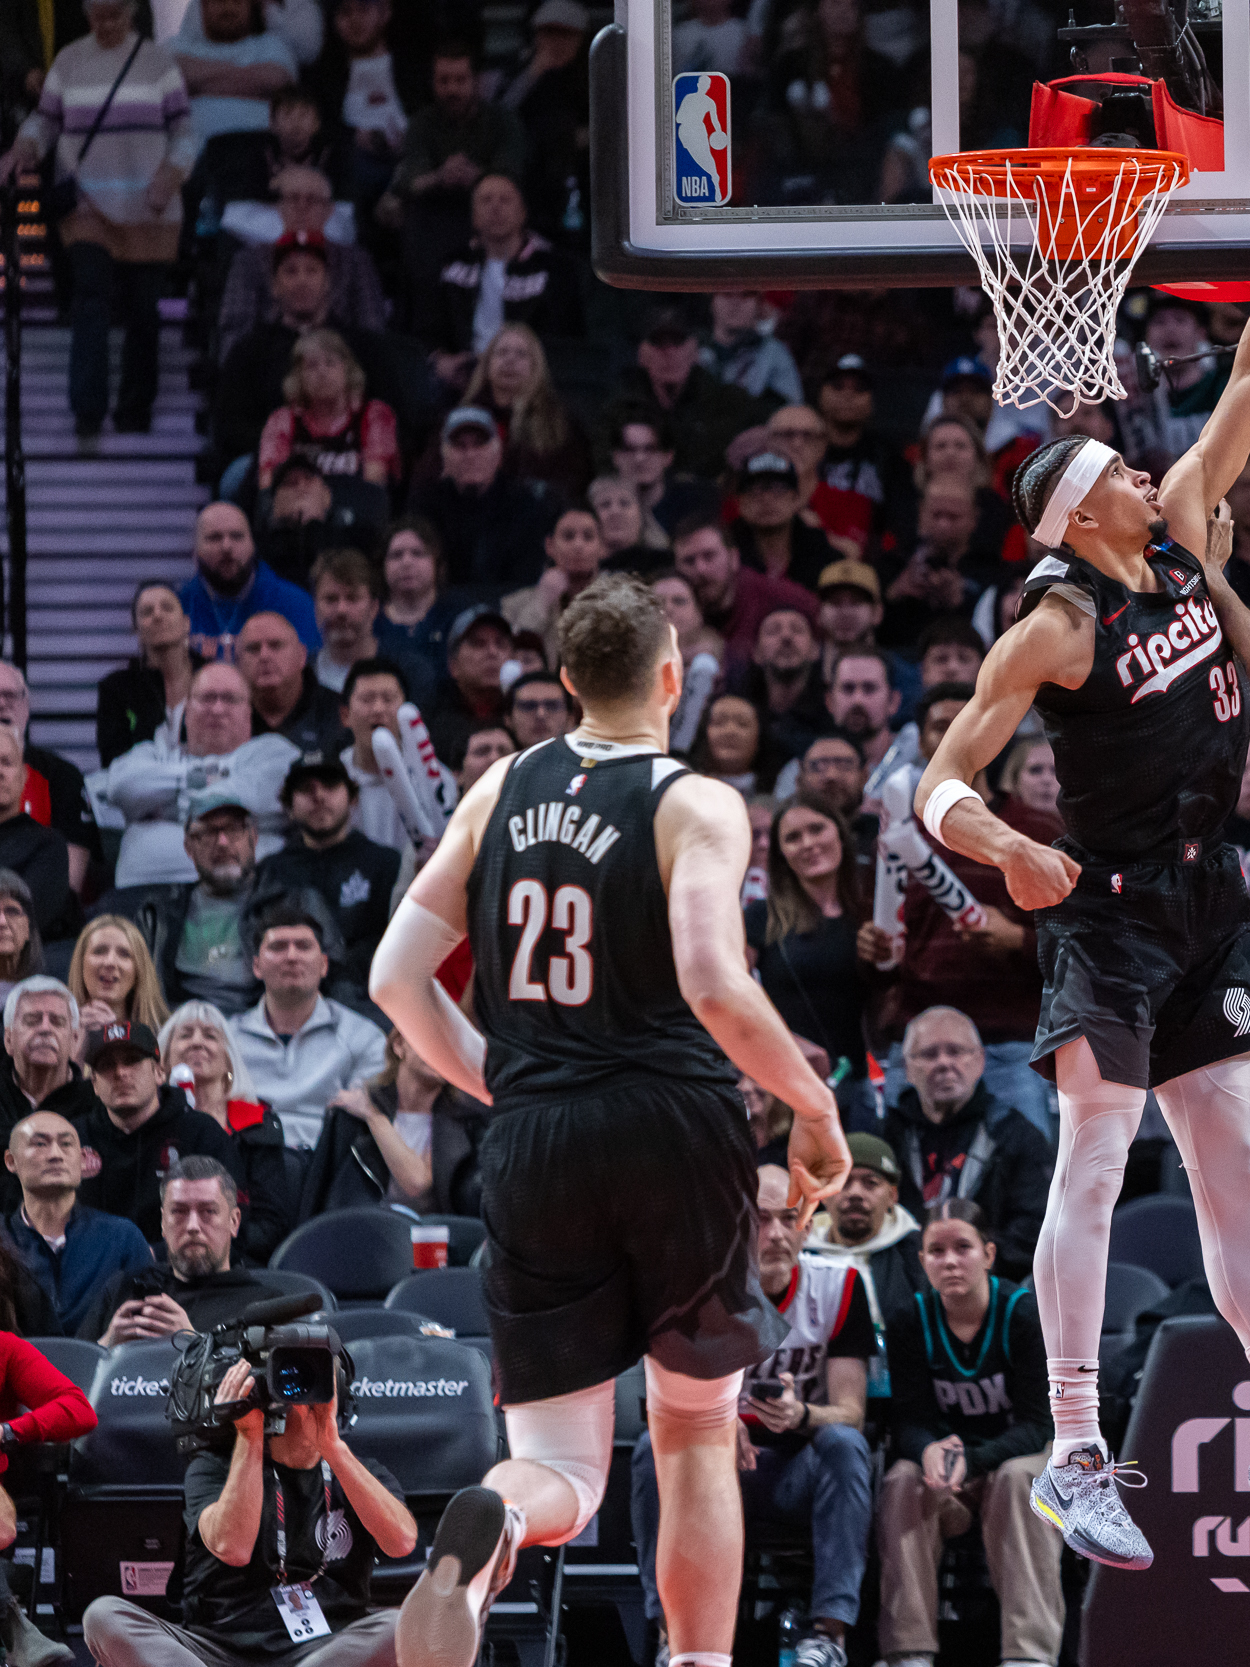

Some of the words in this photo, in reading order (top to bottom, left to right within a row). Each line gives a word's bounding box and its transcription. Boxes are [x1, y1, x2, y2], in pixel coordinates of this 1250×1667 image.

[681, 176, 710, 198] NBA
[1208, 660, 1242, 723] 33
[507, 801, 622, 865] CLINGAN
[507, 877, 594, 1007] 23
[349, 1376, 469, 1398] cketmaster
[933, 1373, 1009, 1416] PDX
